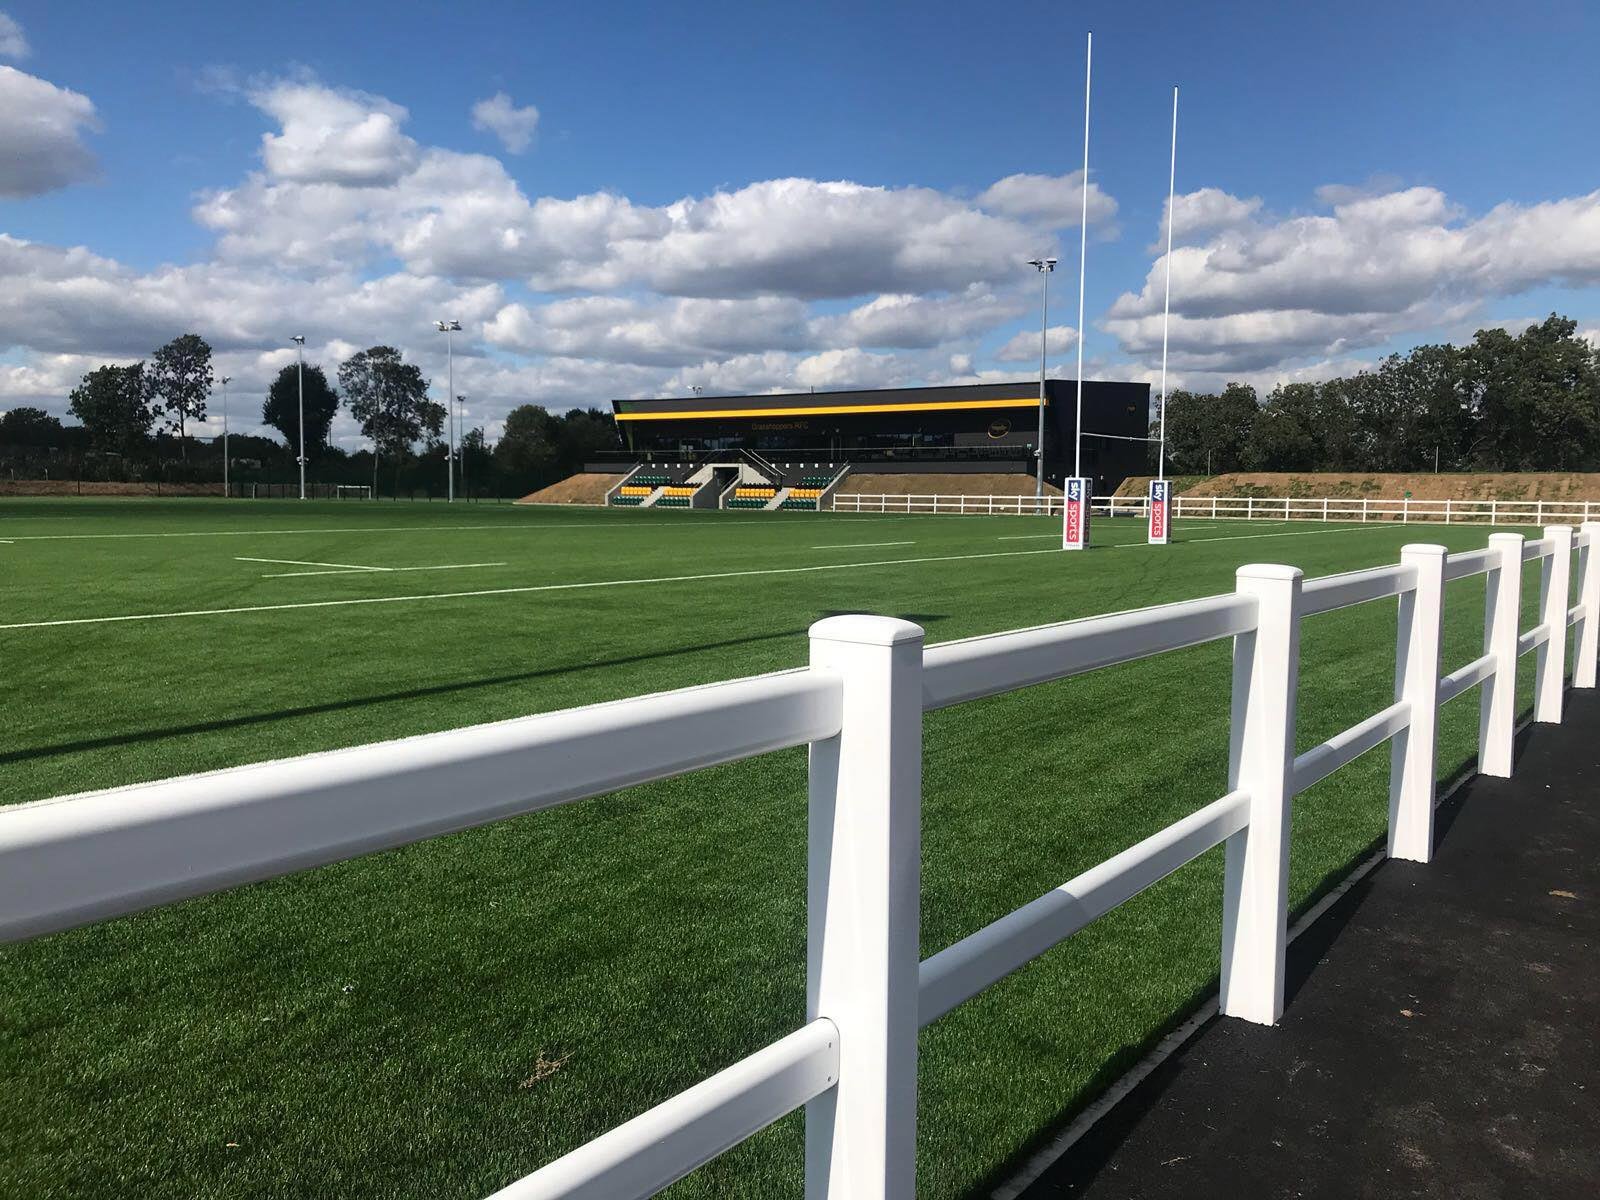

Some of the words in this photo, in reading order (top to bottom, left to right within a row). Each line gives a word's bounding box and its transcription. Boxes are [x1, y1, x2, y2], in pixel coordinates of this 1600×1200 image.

[1069, 482, 1081, 500] sky
[1154, 484, 1164, 500] sky
[1069, 504, 1077, 540] sports
